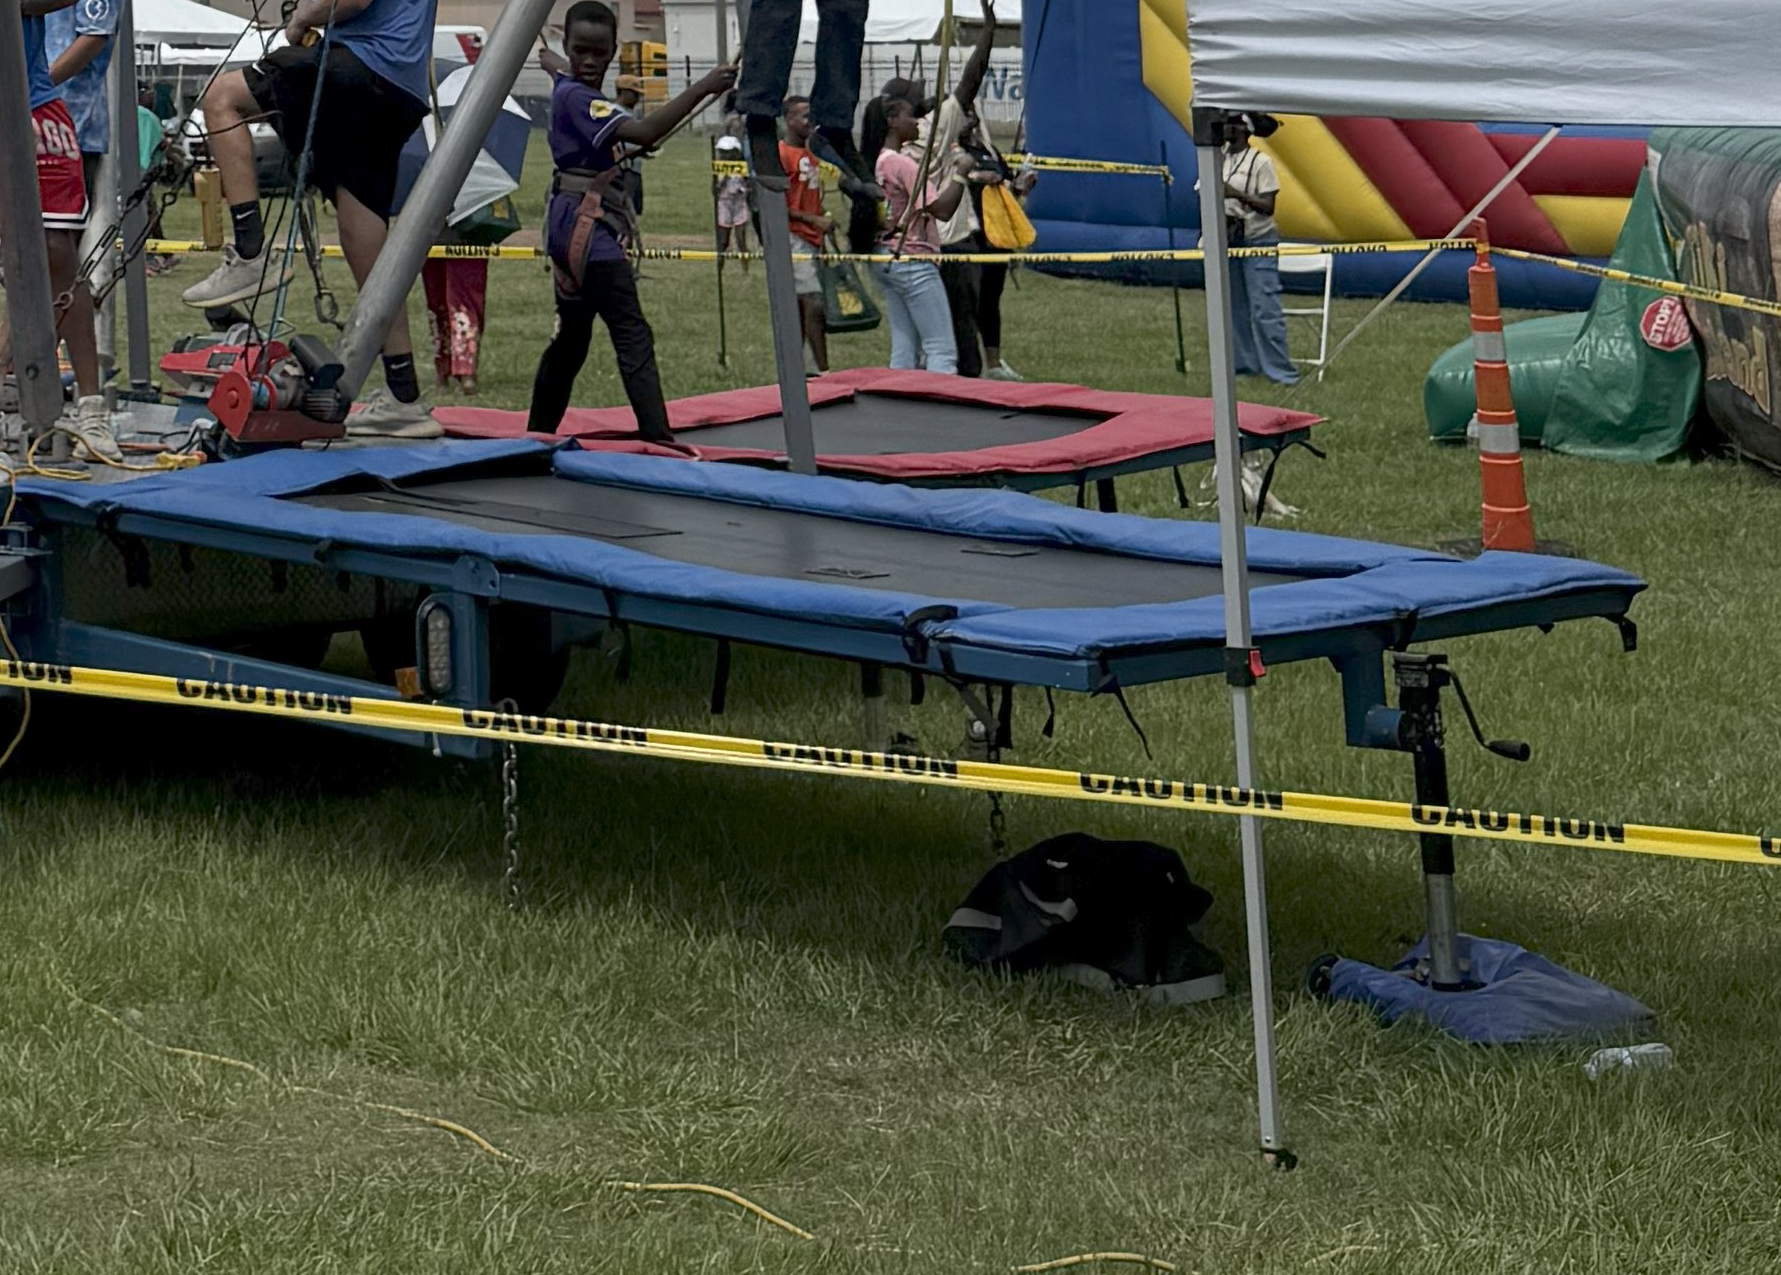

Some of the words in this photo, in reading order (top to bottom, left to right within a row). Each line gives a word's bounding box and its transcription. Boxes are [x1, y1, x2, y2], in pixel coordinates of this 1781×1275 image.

[175, 677, 353, 715] CAUTION
[462, 708, 649, 745] CAUTION
[762, 740, 959, 779] CAUTION
[1079, 772, 1285, 811] CAUTION
[1411, 802, 1626, 844] CAUTION
